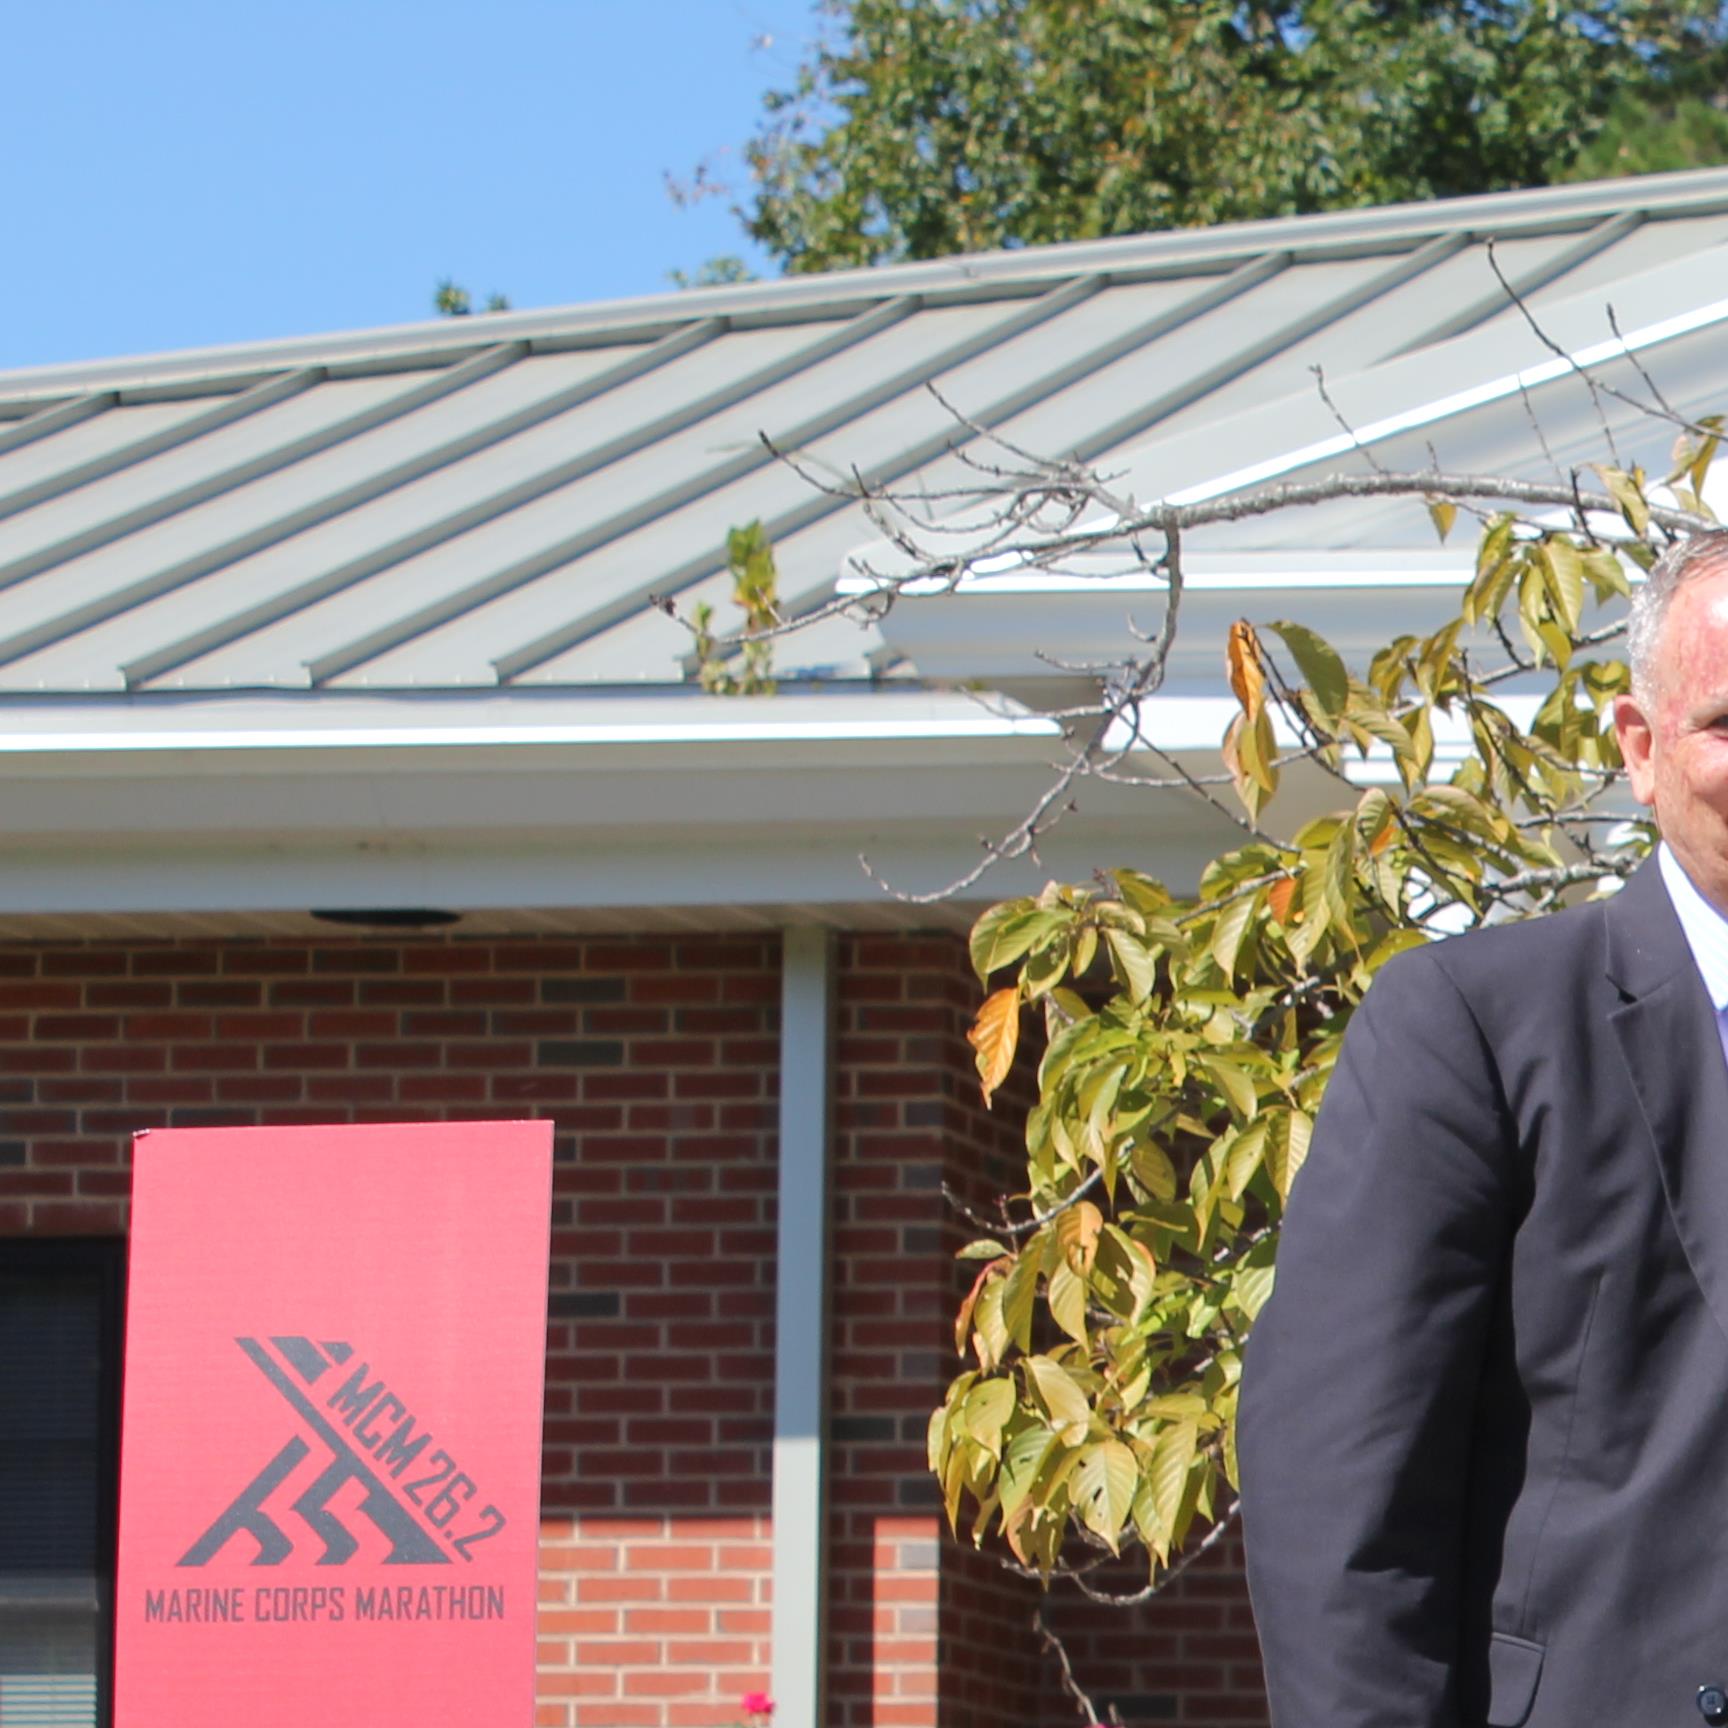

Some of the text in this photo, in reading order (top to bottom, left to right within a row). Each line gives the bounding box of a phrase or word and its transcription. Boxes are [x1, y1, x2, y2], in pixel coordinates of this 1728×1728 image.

[325, 1362, 507, 1563] MCM 26.2
[145, 1584, 505, 1623] MARINE CORPS MARATHON
